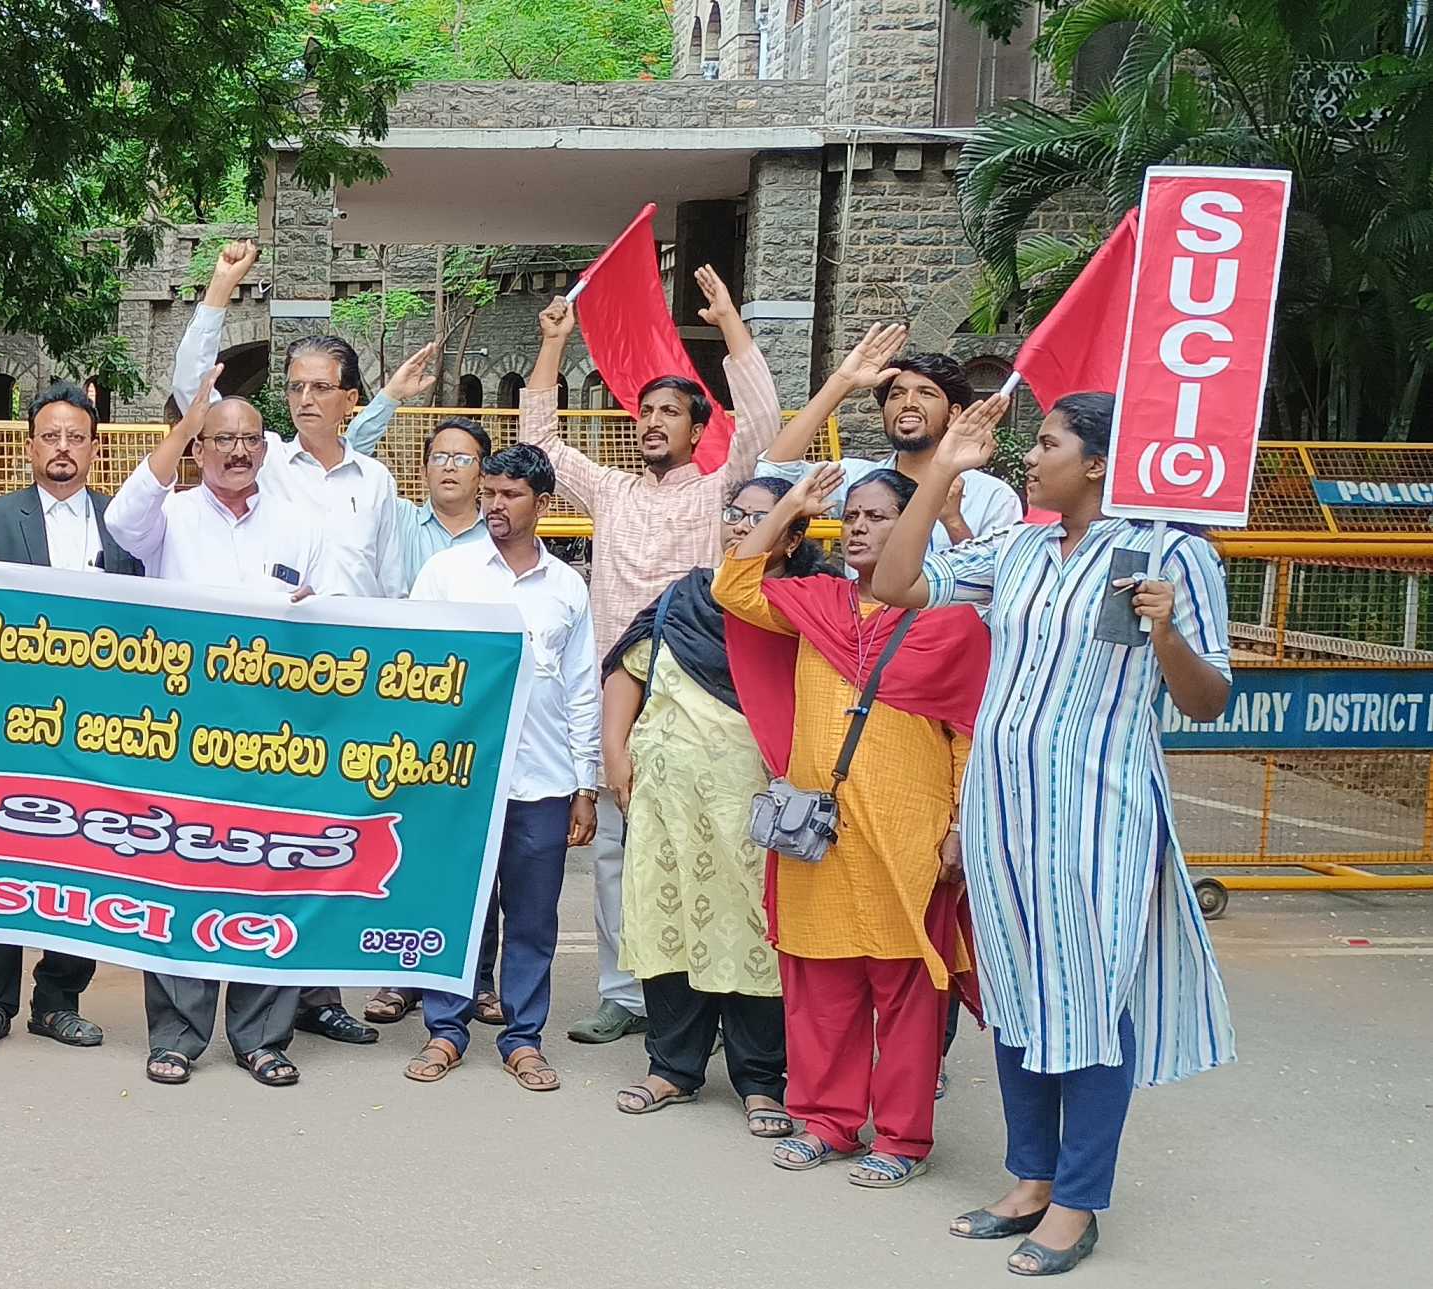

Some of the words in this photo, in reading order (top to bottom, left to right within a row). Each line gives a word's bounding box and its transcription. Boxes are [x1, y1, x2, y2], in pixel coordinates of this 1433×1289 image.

[1159, 190, 1244, 440] SUCI
[1137, 441, 1227, 498] (C)
[1336, 480, 1433, 503] POLIC
[206, 636, 369, 695] ಗಣಿಗಾರಿಕೆ
[377, 650, 467, 706] ಬೇಡ!
[1305, 692, 1423, 733] DISTRICT
[5, 696, 65, 745] ಜನ
[75, 706, 181, 760] ಜೀವನ
[192, 722, 328, 777] ಉಳಿಸಲು
[341, 732, 476, 800] ಆಗ್ರಹಿಸಿ!!
[193, 909, 297, 958] (C)
[360, 928, 445, 968] ಬಳ್ಳಾರಿ
